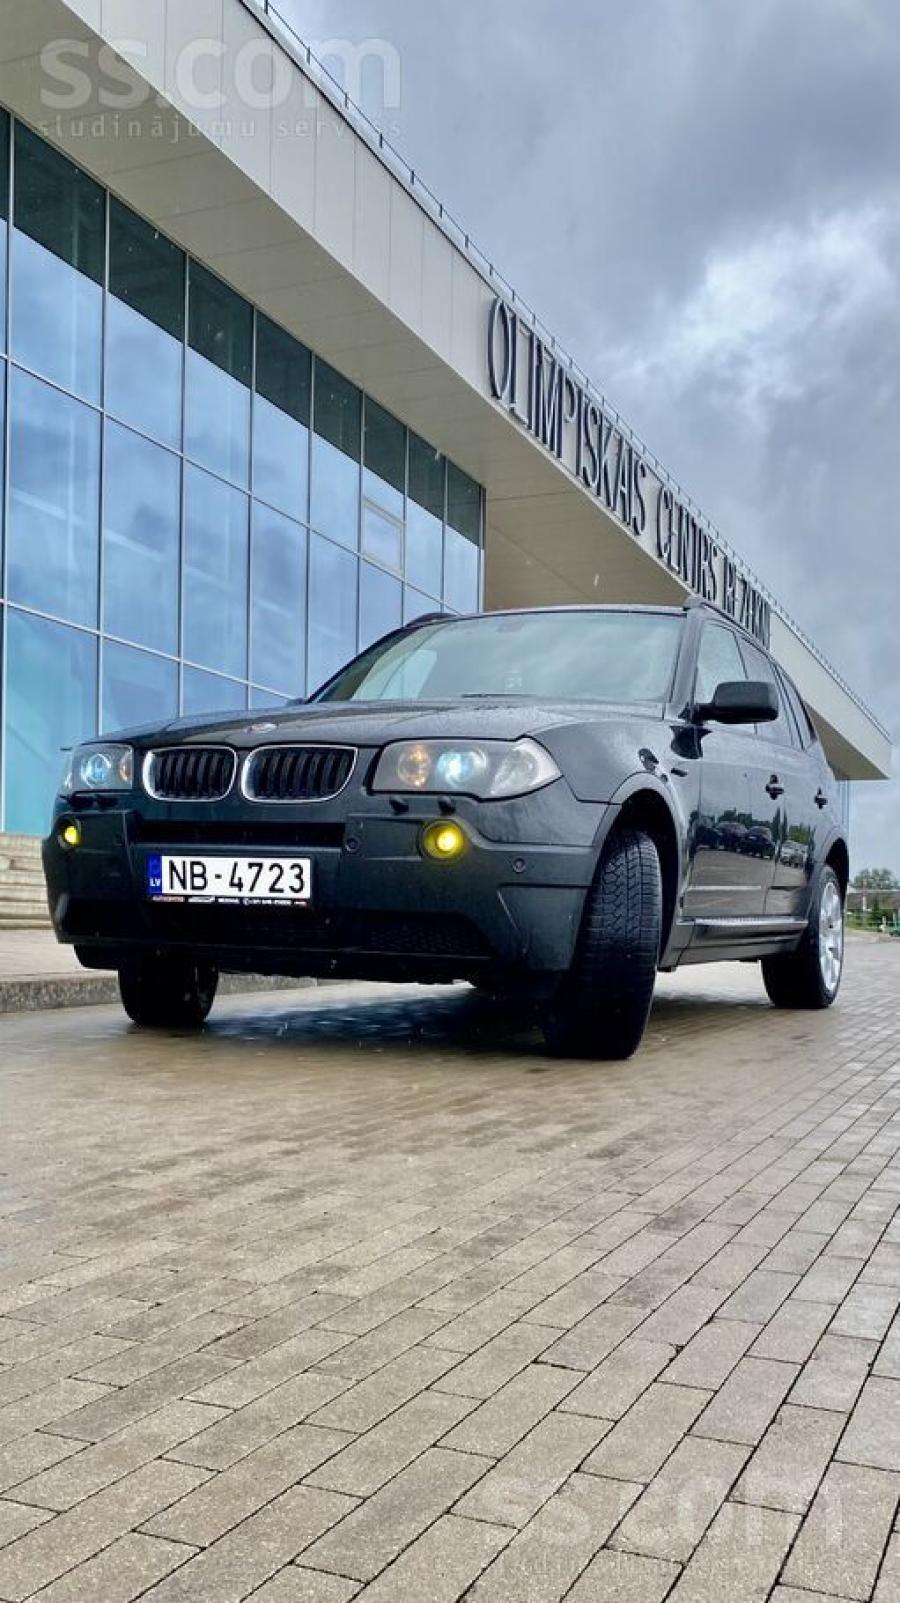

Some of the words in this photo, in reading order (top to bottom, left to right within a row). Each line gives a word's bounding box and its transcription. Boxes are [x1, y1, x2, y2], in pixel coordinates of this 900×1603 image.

[487, 297, 646, 536] OLIMPISKAIS
[656, 484, 718, 601] CENTRS
[150, 878, 161, 887] LV
[168, 859, 305, 894] NB-4723
